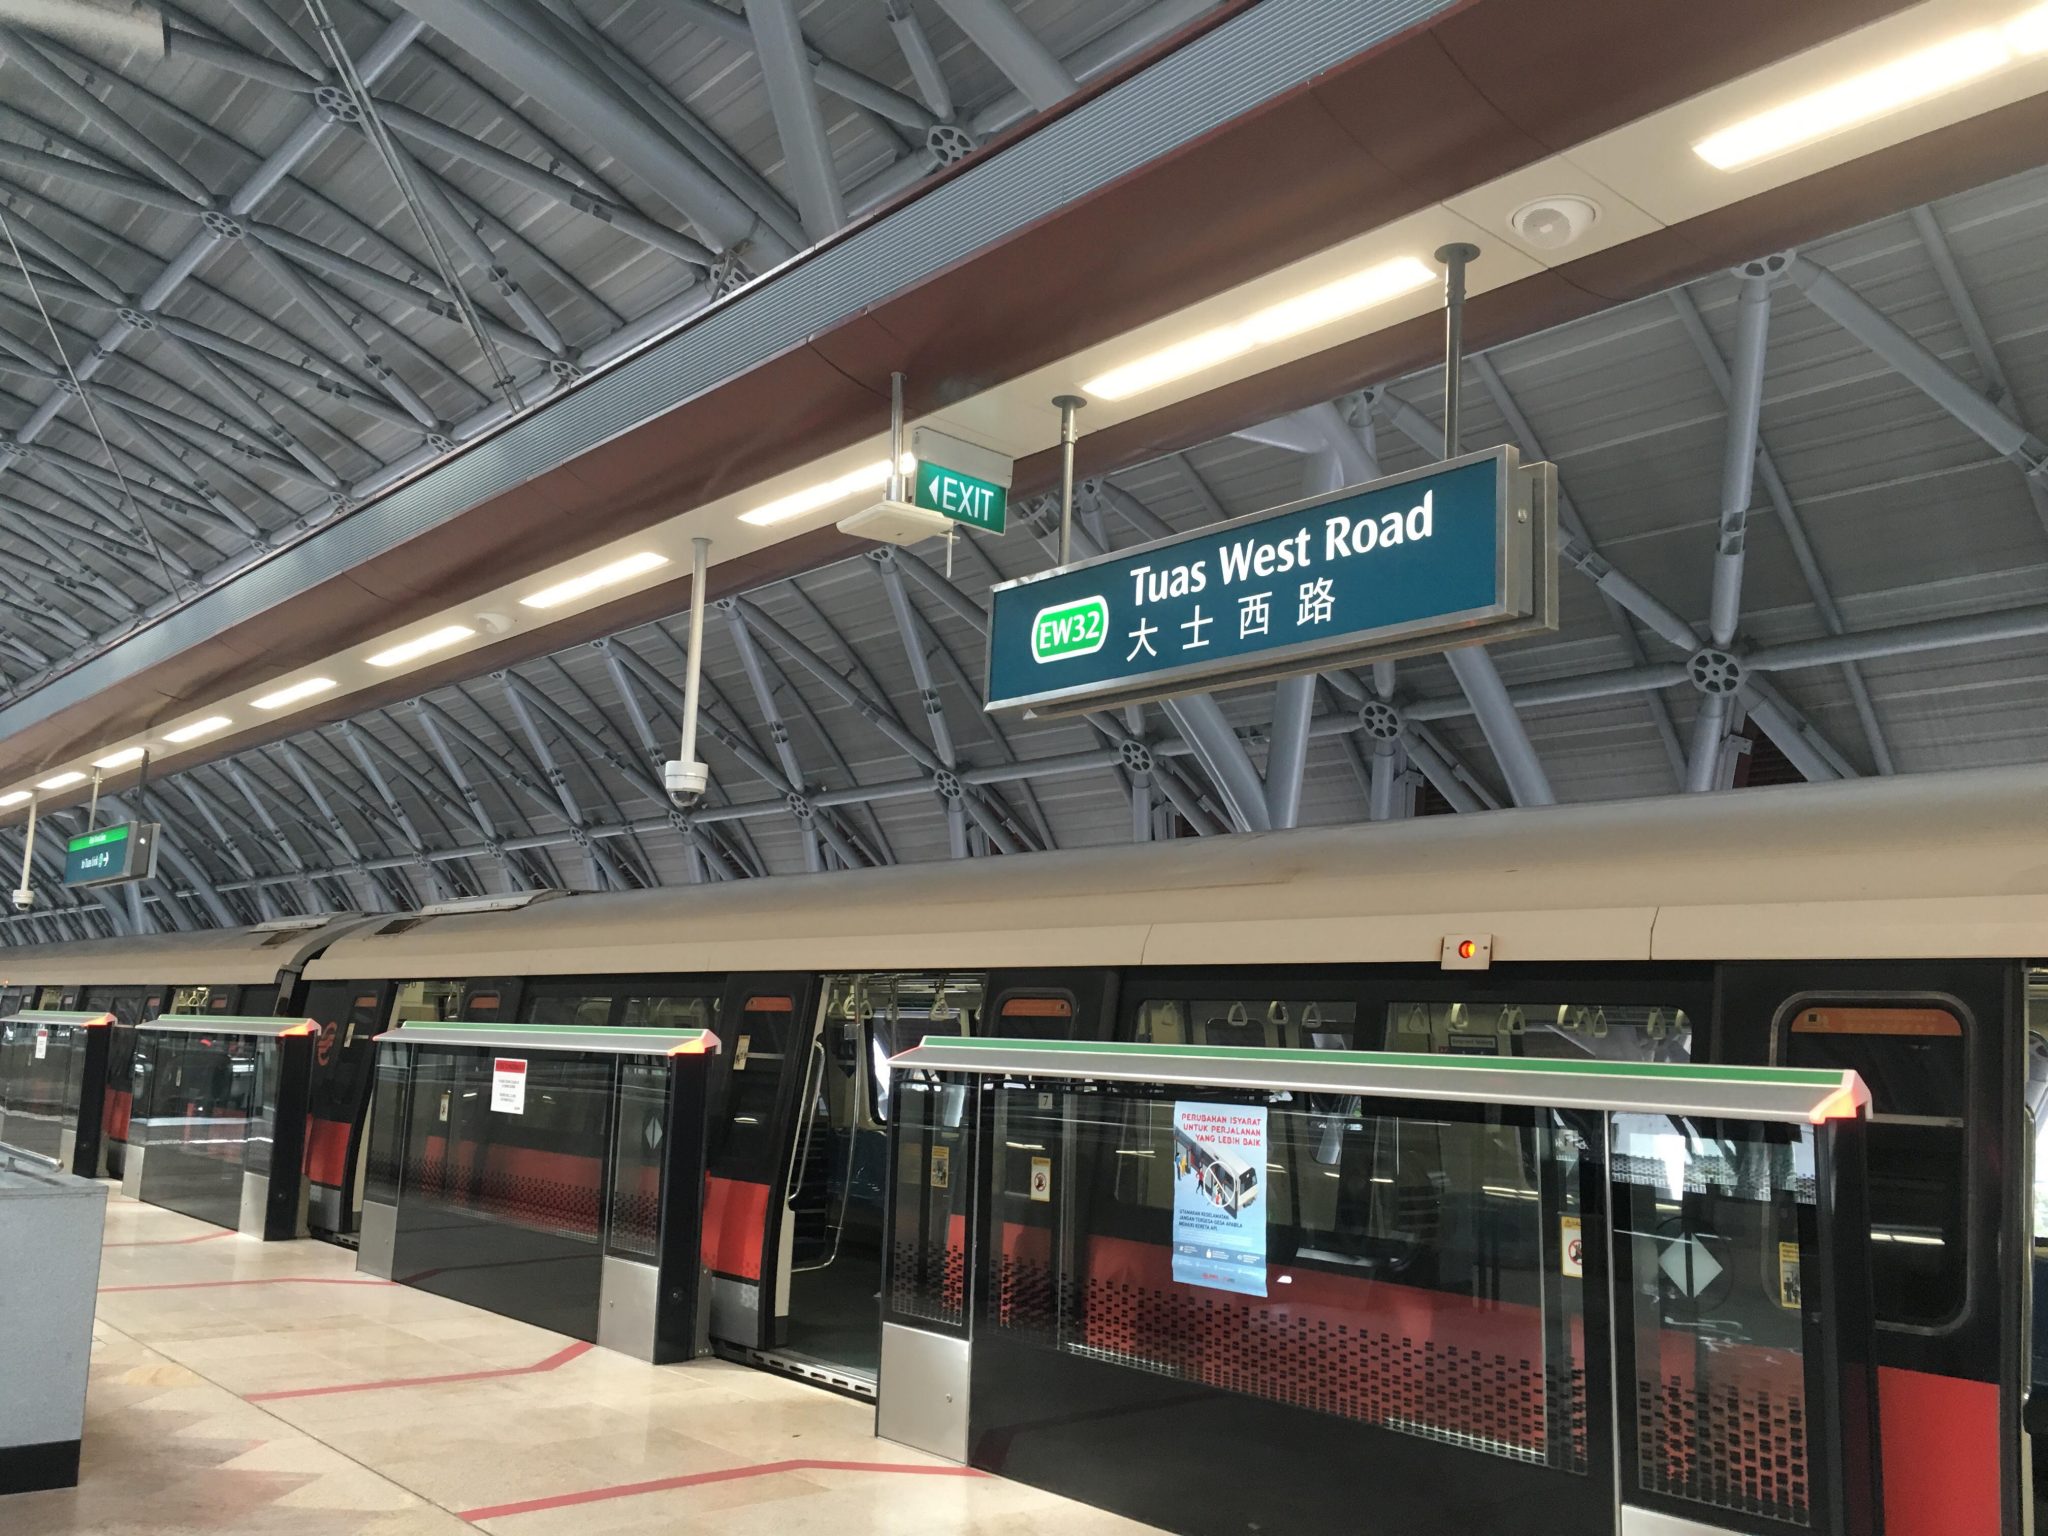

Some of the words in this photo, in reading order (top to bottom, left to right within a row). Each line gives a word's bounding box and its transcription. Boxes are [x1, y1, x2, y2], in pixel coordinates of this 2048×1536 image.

[942, 476, 994, 521] EXIT
[1130, 560, 1207, 606] Tuas
[1219, 527, 1311, 585] West
[1325, 489, 1433, 561] Road
[1039, 610, 1100, 649] EW32
[1126, 576, 1336, 662] 大士西路
[1181, 1113, 1227, 1123] PERUBAHAN
[1229, 1116, 1262, 1126] ISYARAT
[1183, 1123, 1208, 1132] UNTUK
[1211, 1125, 1261, 1137] PERJALANAN
[1195, 1134, 1216, 1143] YANG
[1218, 1136, 1240, 1145] LEBIH
[1242, 1138, 1261, 1147] BAIK
